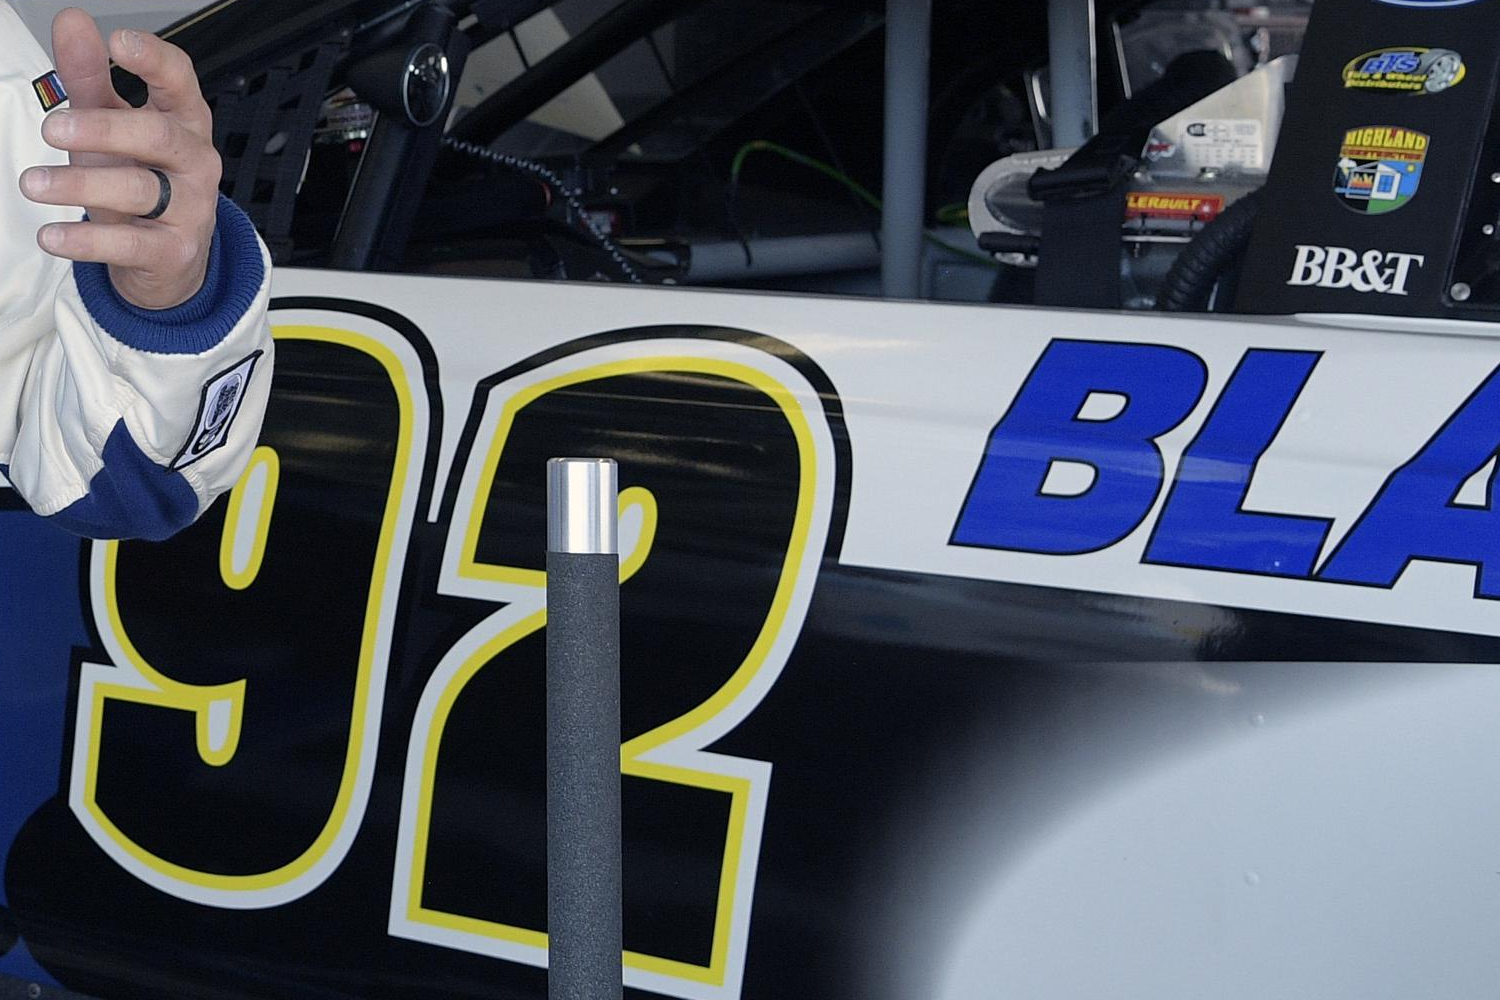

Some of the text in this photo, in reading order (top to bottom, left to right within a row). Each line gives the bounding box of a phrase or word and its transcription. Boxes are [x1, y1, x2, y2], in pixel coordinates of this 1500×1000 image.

[1345, 127, 1427, 150] HIGHLAND
[1286, 244, 1425, 296] BB&T
[947, 336, 1500, 600] BLA
[69, 300, 842, 1000] 92
